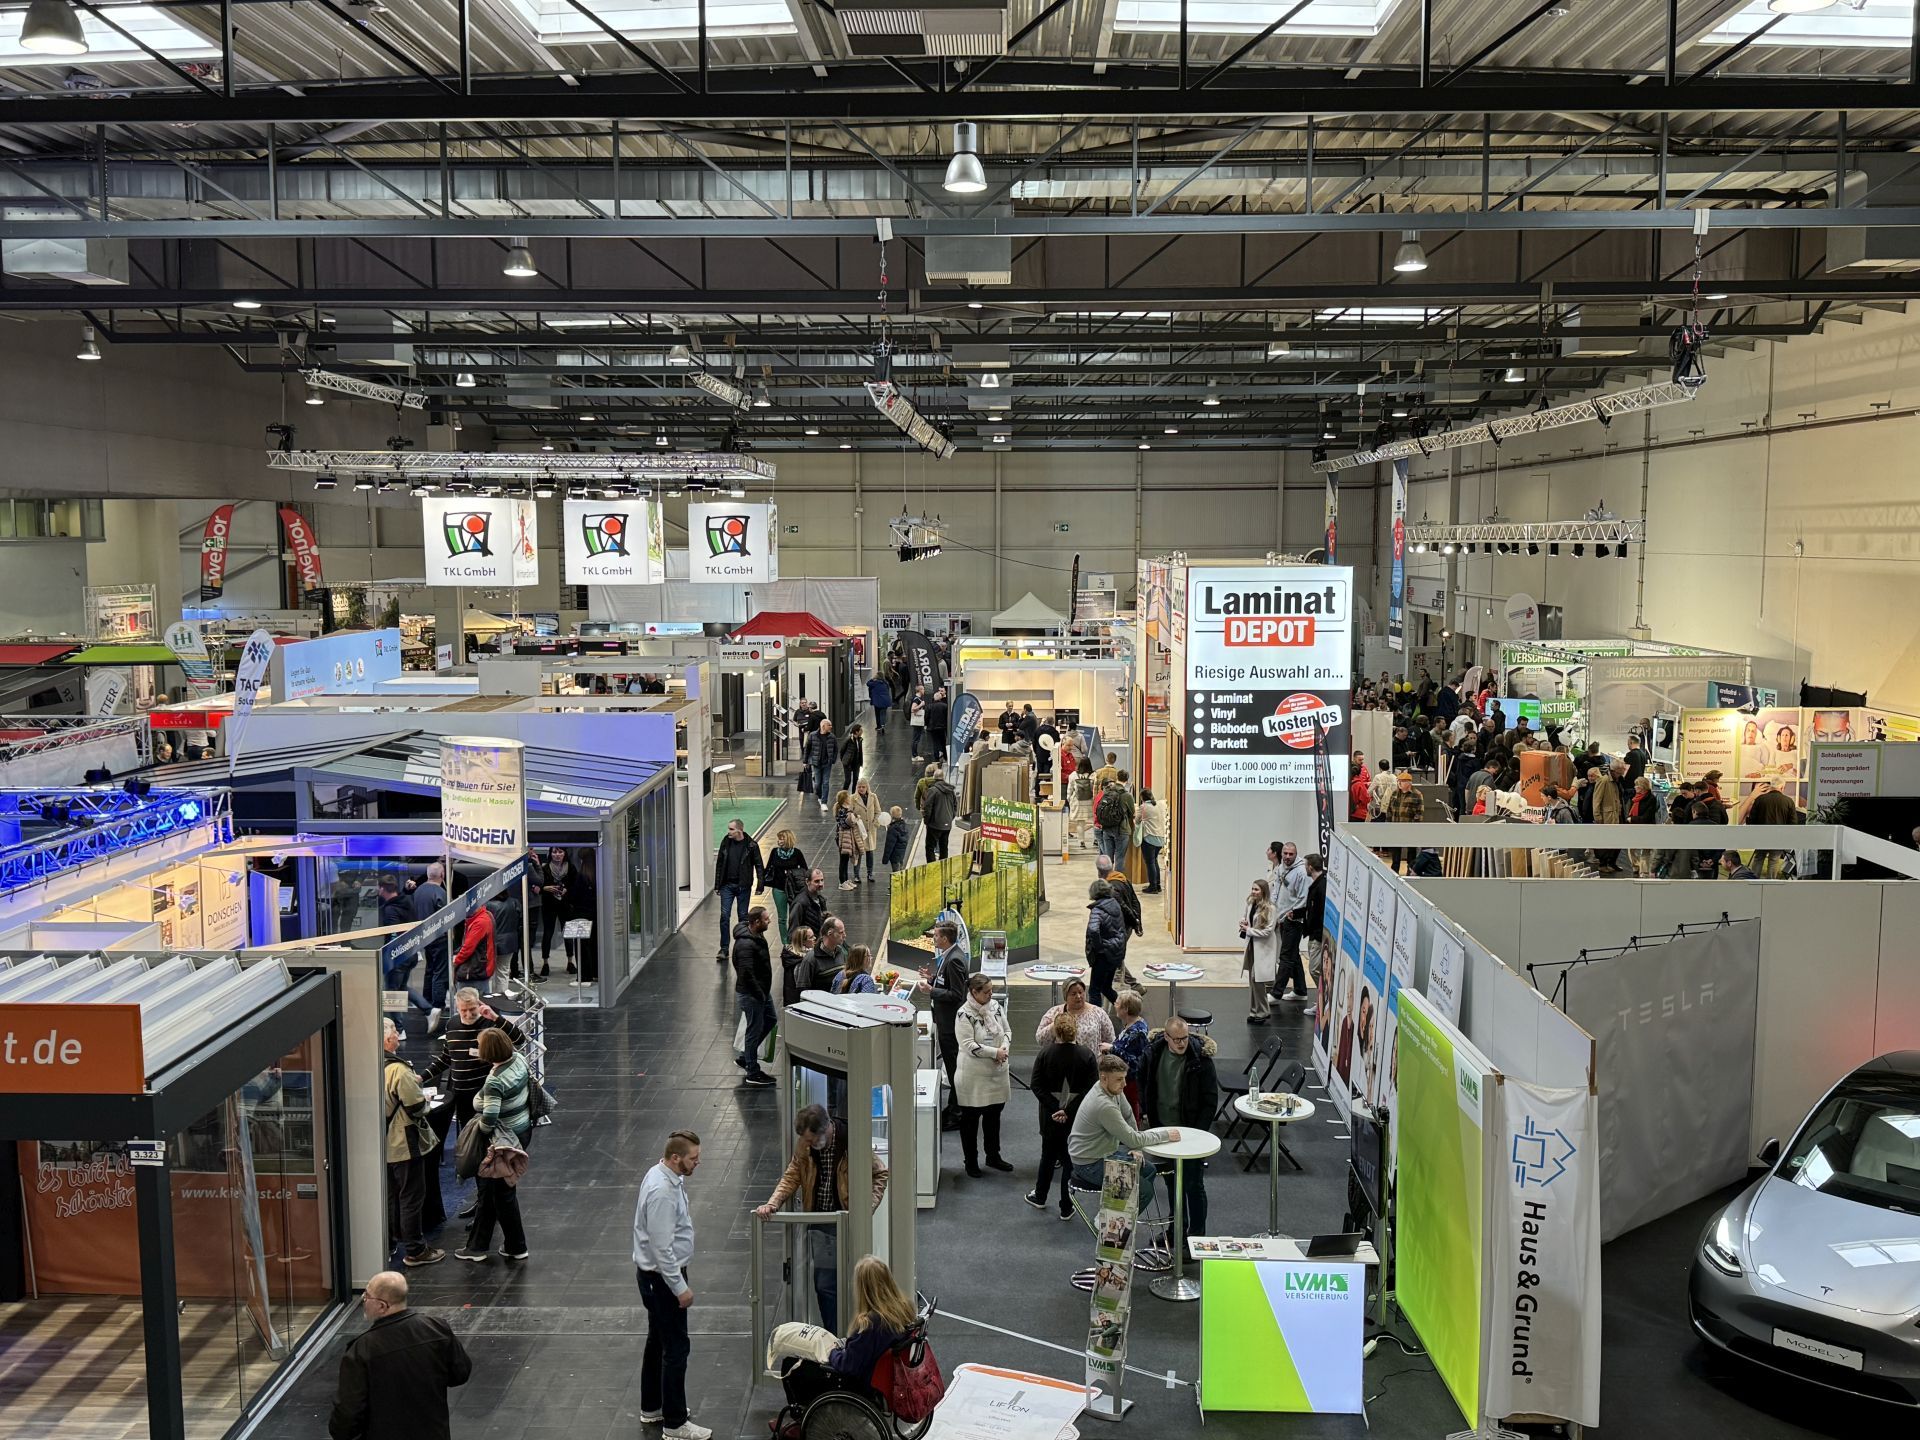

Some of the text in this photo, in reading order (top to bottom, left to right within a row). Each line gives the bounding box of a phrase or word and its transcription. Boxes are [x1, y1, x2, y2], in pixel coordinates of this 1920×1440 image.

[206, 515, 228, 581] weior
[443, 567, 496, 577] TKL GmbH
[582, 566, 632, 576] TKL GmbH
[705, 566, 753, 575] TKL GmbH
[1205, 586, 1336, 614] Laminat
[1230, 620, 1309, 643] DEPOT
[1195, 665, 1344, 681] Riesige Auswahl an...
[1211, 693, 1253, 704] Laminat
[1211, 708, 1236, 720] Vinyl
[1541, 701, 1576, 714] NSTIGER
[953, 707, 976, 741] MEDA
[1210, 723, 1259, 734] Bioboden
[1268, 711, 1338, 734] kostenlos
[1210, 738, 1249, 749] Parkett
[1211, 760, 1231, 771] Über
[1234, 762, 1277, 771] 1.000.000
[481, 782, 494, 792] für
[497, 783, 516, 792] Sie!
[1199, 774, 1242, 786] verfügbar
[1245, 774, 1256, 784] im
[1007, 808, 1033, 821] Laminat
[444, 822, 516, 845] DONSCHEN
[207, 900, 242, 926] DONSCHEN
[1618, 982, 1714, 1031] TESLA
[4, 1029, 82, 1065] t.de
[1460, 1067, 1473, 1096] LVM
[135, 1151, 159, 1159] 3.323
[1519, 1201, 1546, 1266] Haus
[1285, 1272, 1328, 1291] LVM
[1517, 1270, 1540, 1290] &
[1285, 1292, 1349, 1300] VERSICHERUNG
[1786, 1338, 1836, 1358] MODEL
[1088, 1357, 1107, 1368] LVM
[989, 1399, 1031, 1414] LIFTON
